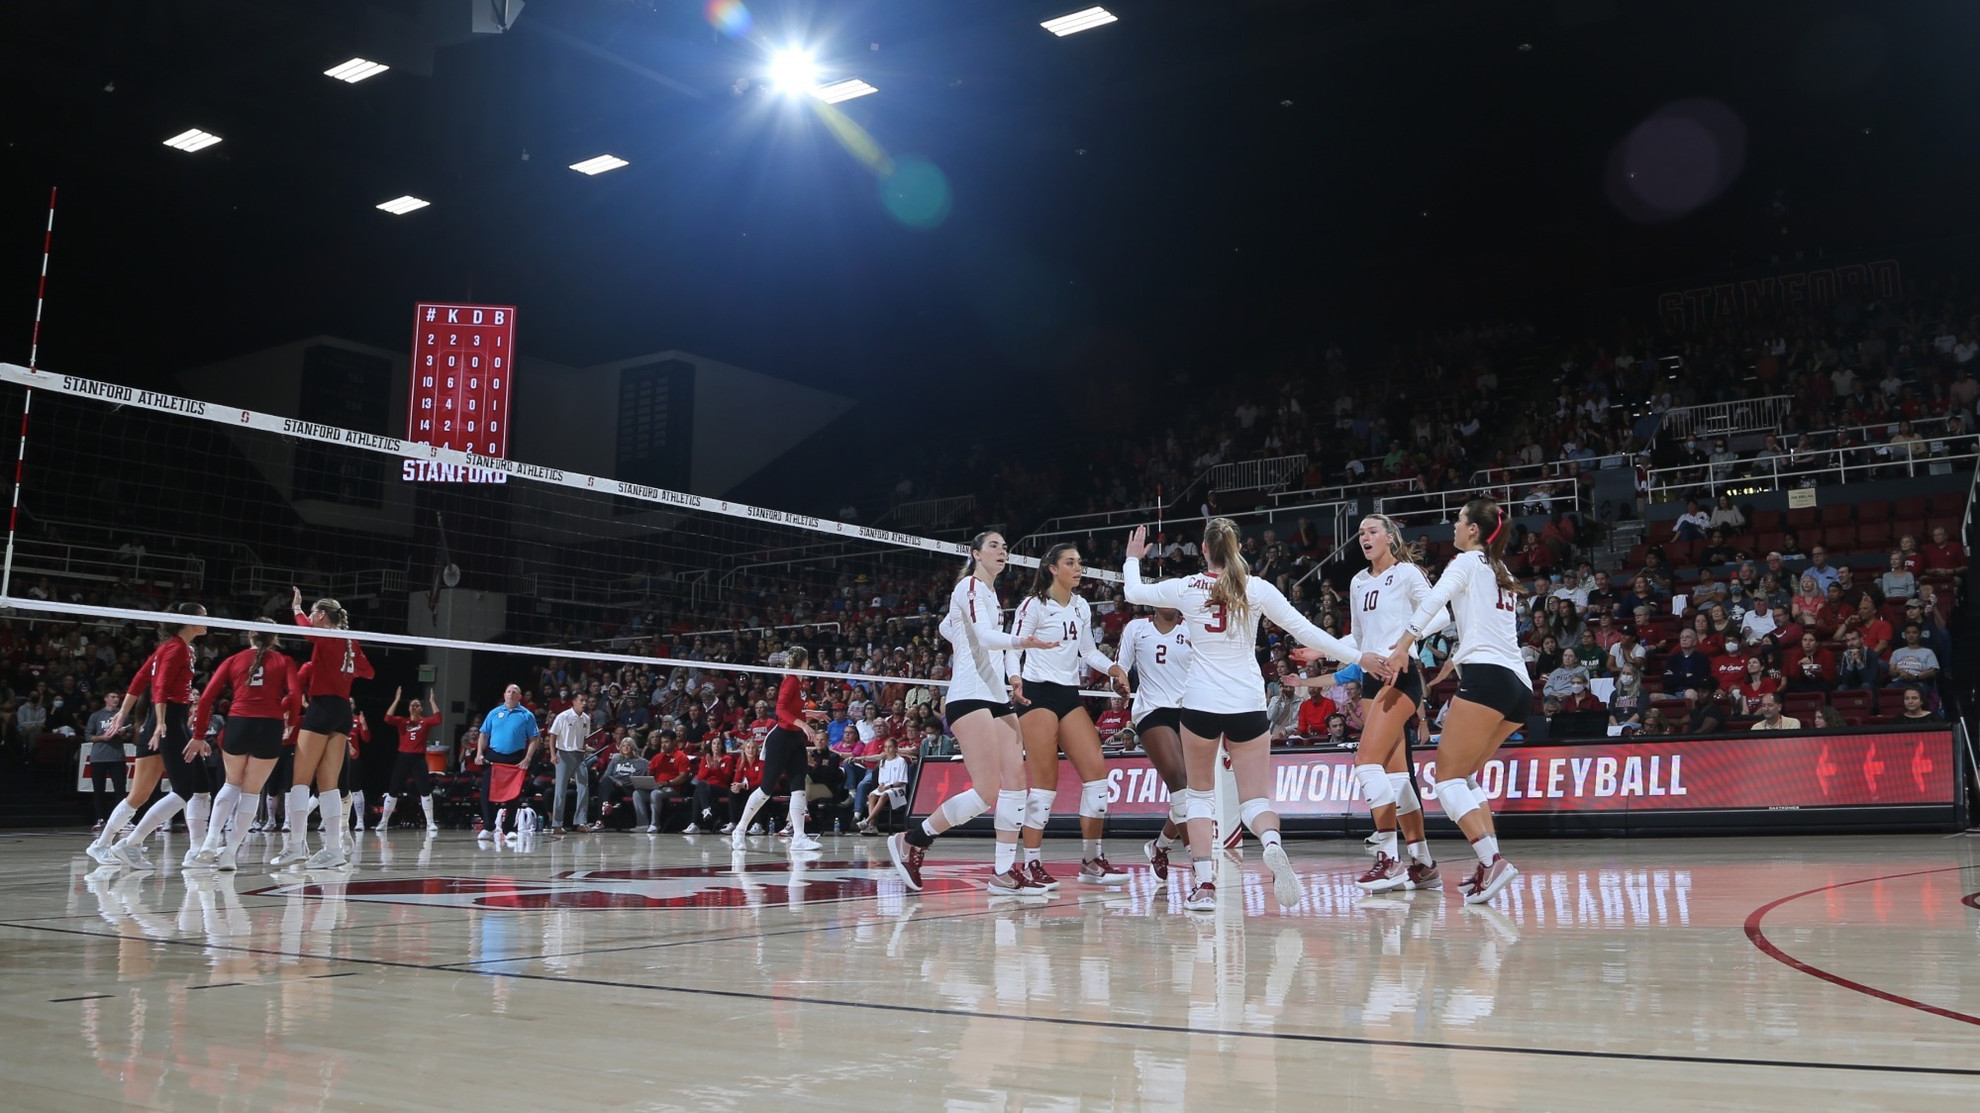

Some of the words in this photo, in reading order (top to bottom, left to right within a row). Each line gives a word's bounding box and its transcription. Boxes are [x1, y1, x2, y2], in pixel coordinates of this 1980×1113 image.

[448, 309, 459, 323] K
[473, 310, 483, 324] D
[495, 311, 505, 325] B
[427, 334, 435, 345] 2
[450, 334, 457, 345] 2
[473, 335, 480, 346] 3
[426, 355, 433, 366] 3
[448, 355, 455, 366] 0
[471, 356, 478, 368] 0
[494, 357, 501, 368] 0
[422, 376, 433, 388] 10
[447, 377, 454, 388] 6
[470, 377, 477, 389] 0
[493, 378, 500, 390] 0
[63, 376, 133, 401] STANFORD
[137, 390, 206, 416] ATHLETICS
[421, 398, 432, 409] 13
[445, 398, 452, 410] 4
[469, 399, 476, 411] 0
[283, 419, 341, 441] STANFORD
[345, 430, 400, 452] ATHLETICS
[420, 419, 430, 430] 14
[444, 419, 451, 431] 2
[467, 420, 475, 432] 0
[490, 421, 497, 432] 0
[466, 442, 473, 453] 2
[489, 442, 496, 454] 0
[402, 459, 507, 484] STANFORD
[466, 453, 513, 472] STANFORD
[516, 463, 563, 482] ATHLETICS
[618, 482, 658, 500] STANFORD
[661, 490, 701, 508] ATHLETICS
[747, 506, 782, 522] STANFORD
[784, 512, 819, 528] ATHLETICS
[859, 526, 889, 541] STANFORD
[891, 532, 922, 547] ATHLETICS
[1362, 589, 1379, 612] 10
[1204, 599, 1227, 633] 3
[1062, 620, 1078, 641] 14
[1156, 644, 1167, 665] 2
[251, 665, 264, 687] 2
[410, 732, 417, 741] 5
[1477, 754, 1688, 802] OLLEYBALL
